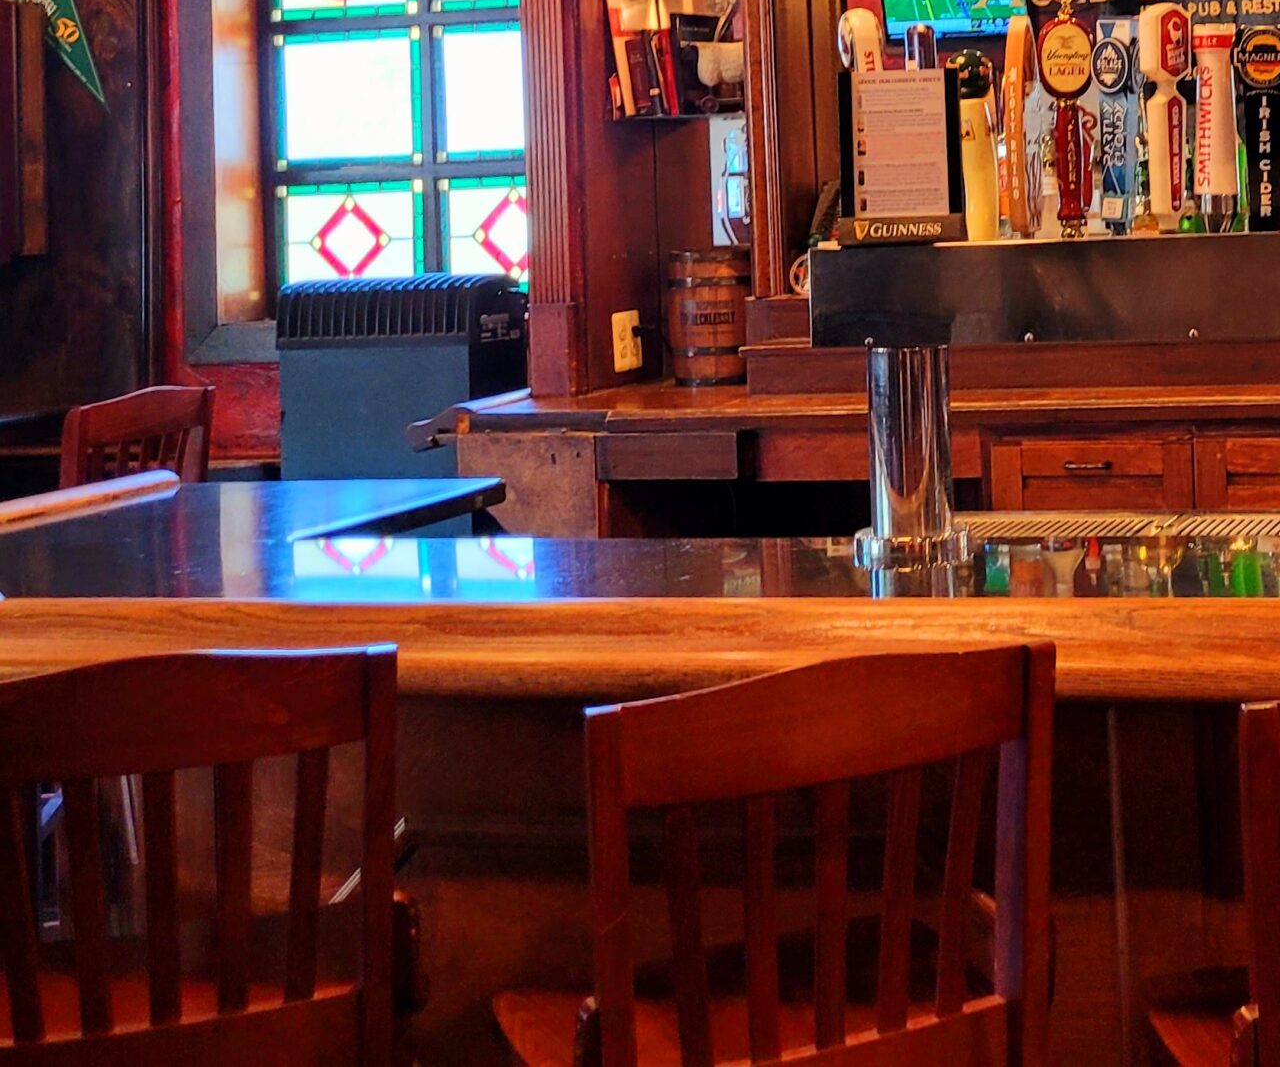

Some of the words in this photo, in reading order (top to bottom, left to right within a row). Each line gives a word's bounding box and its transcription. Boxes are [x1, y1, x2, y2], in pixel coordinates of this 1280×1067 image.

[1187, 1, 1221, 19] PUB
[1049, 66, 1086, 76] LAGER
[1259, 95, 1272, 154] IRISH
[1259, 159, 1273, 218] CIDER
[869, 221, 943, 238] GUINNESS
